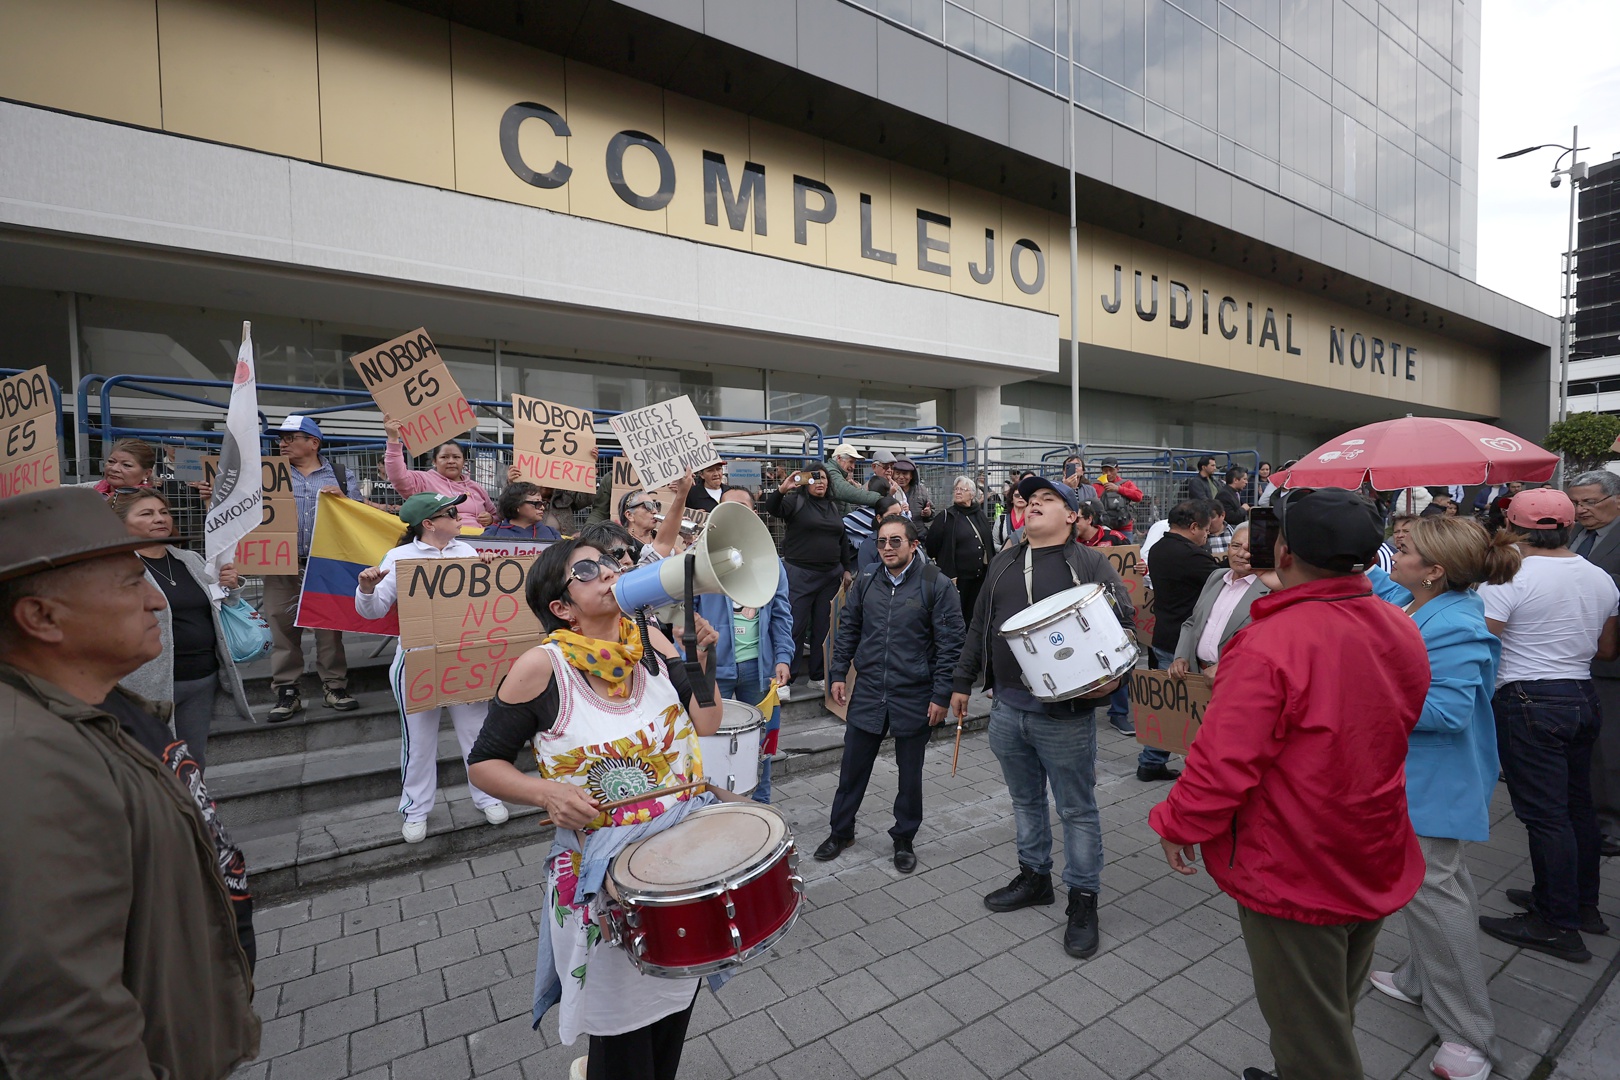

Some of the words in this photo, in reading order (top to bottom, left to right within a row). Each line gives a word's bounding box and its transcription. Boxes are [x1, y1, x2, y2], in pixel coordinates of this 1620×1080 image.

[499, 101, 1046, 295] COMPLEJO
[1101, 264, 1302, 356] JUDICIAL
[1329, 325, 1418, 381] NORTE
[360, 333, 437, 386] NOBOA
[0, 373, 48, 419] BOA
[403, 369, 440, 406] ES
[400, 397, 475, 450] MAFIA
[518, 397, 596, 434] NOBOA
[664, 403, 673, 419] Y
[7, 420, 36, 457] ES
[540, 429, 578, 456] ES
[627, 419, 683, 449] FISCALES
[634, 432, 698, 468] SIRVIENTES
[517, 454, 596, 488] MUERTE
[641, 467, 658, 486] DE
[658, 459, 679, 479] LOS
[677, 442, 718, 471] NARCOS
[408, 559, 525, 599] NOBO
[462, 594, 518, 627] NO
[456, 627, 508, 662] ES
[1051, 634, 1062, 643] 04
[1129, 674, 1188, 713] NOBOA
[1134, 707, 1162, 744] LA
